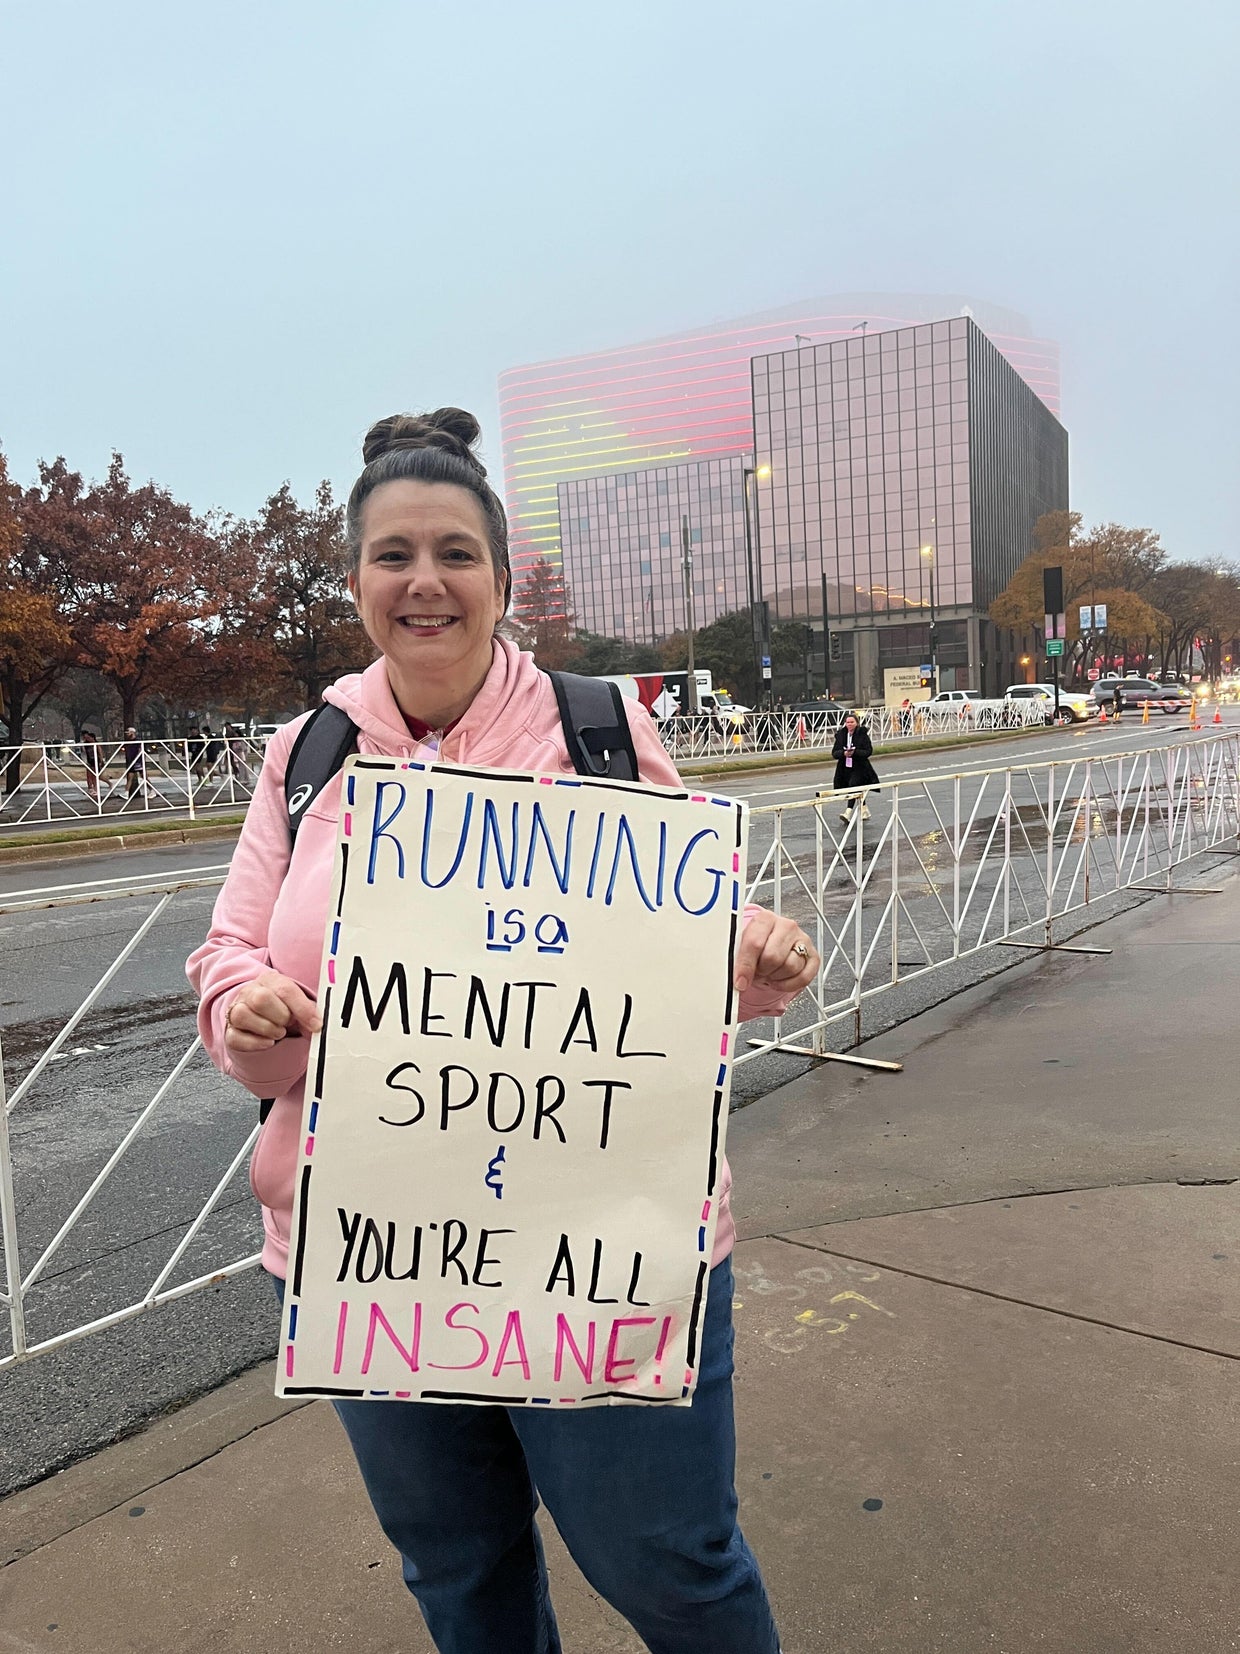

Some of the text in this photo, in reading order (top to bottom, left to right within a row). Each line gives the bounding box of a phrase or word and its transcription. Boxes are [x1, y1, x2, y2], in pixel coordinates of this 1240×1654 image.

[367, 781, 727, 916] RUNNING
[341, 956, 667, 1059] MENTAL
[378, 1062, 632, 1150] SPORT
[336, 1207, 651, 1307] YOU'RE ALL
[333, 1301, 672, 1386] INSANE!
